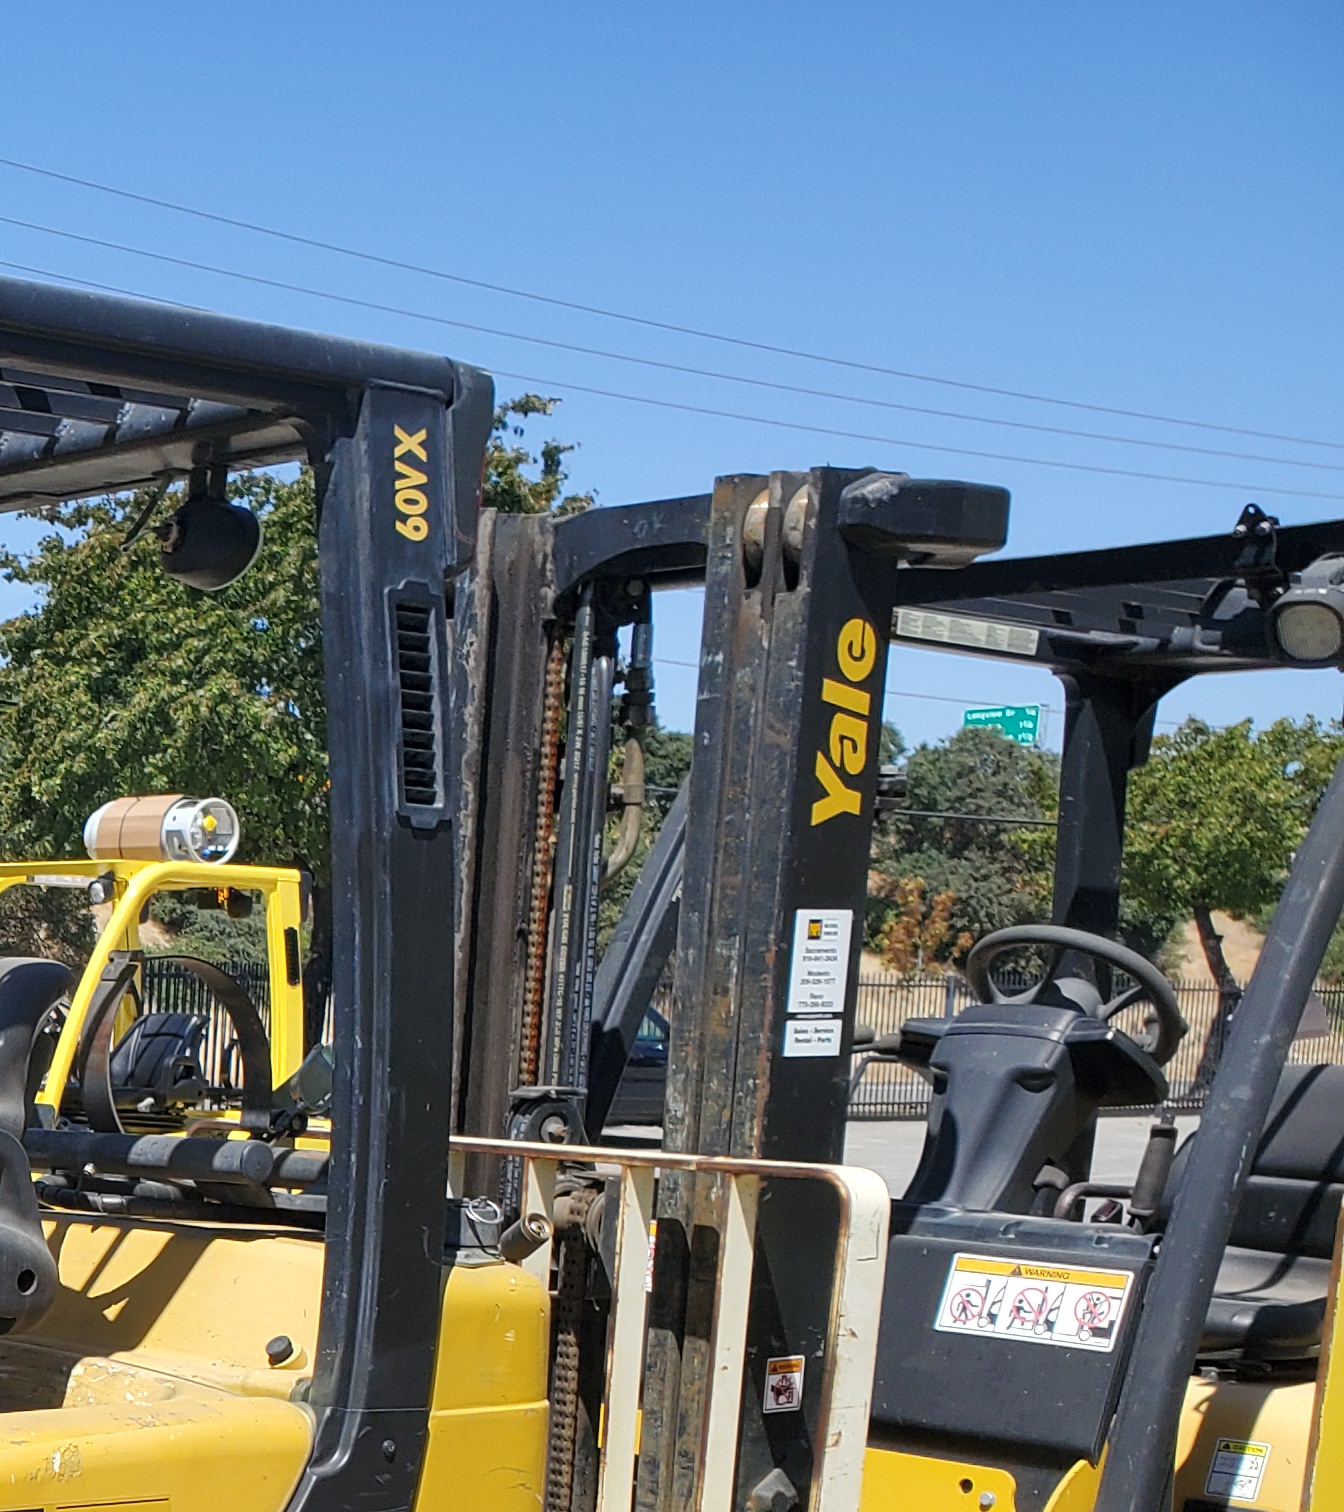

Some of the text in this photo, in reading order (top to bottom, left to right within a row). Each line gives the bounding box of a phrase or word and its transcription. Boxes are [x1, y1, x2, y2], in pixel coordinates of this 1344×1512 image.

[394, 423, 428, 542] 60VX
[811, 617, 875, 826] Yale
[1024, 1268, 1070, 1280] WARNING
